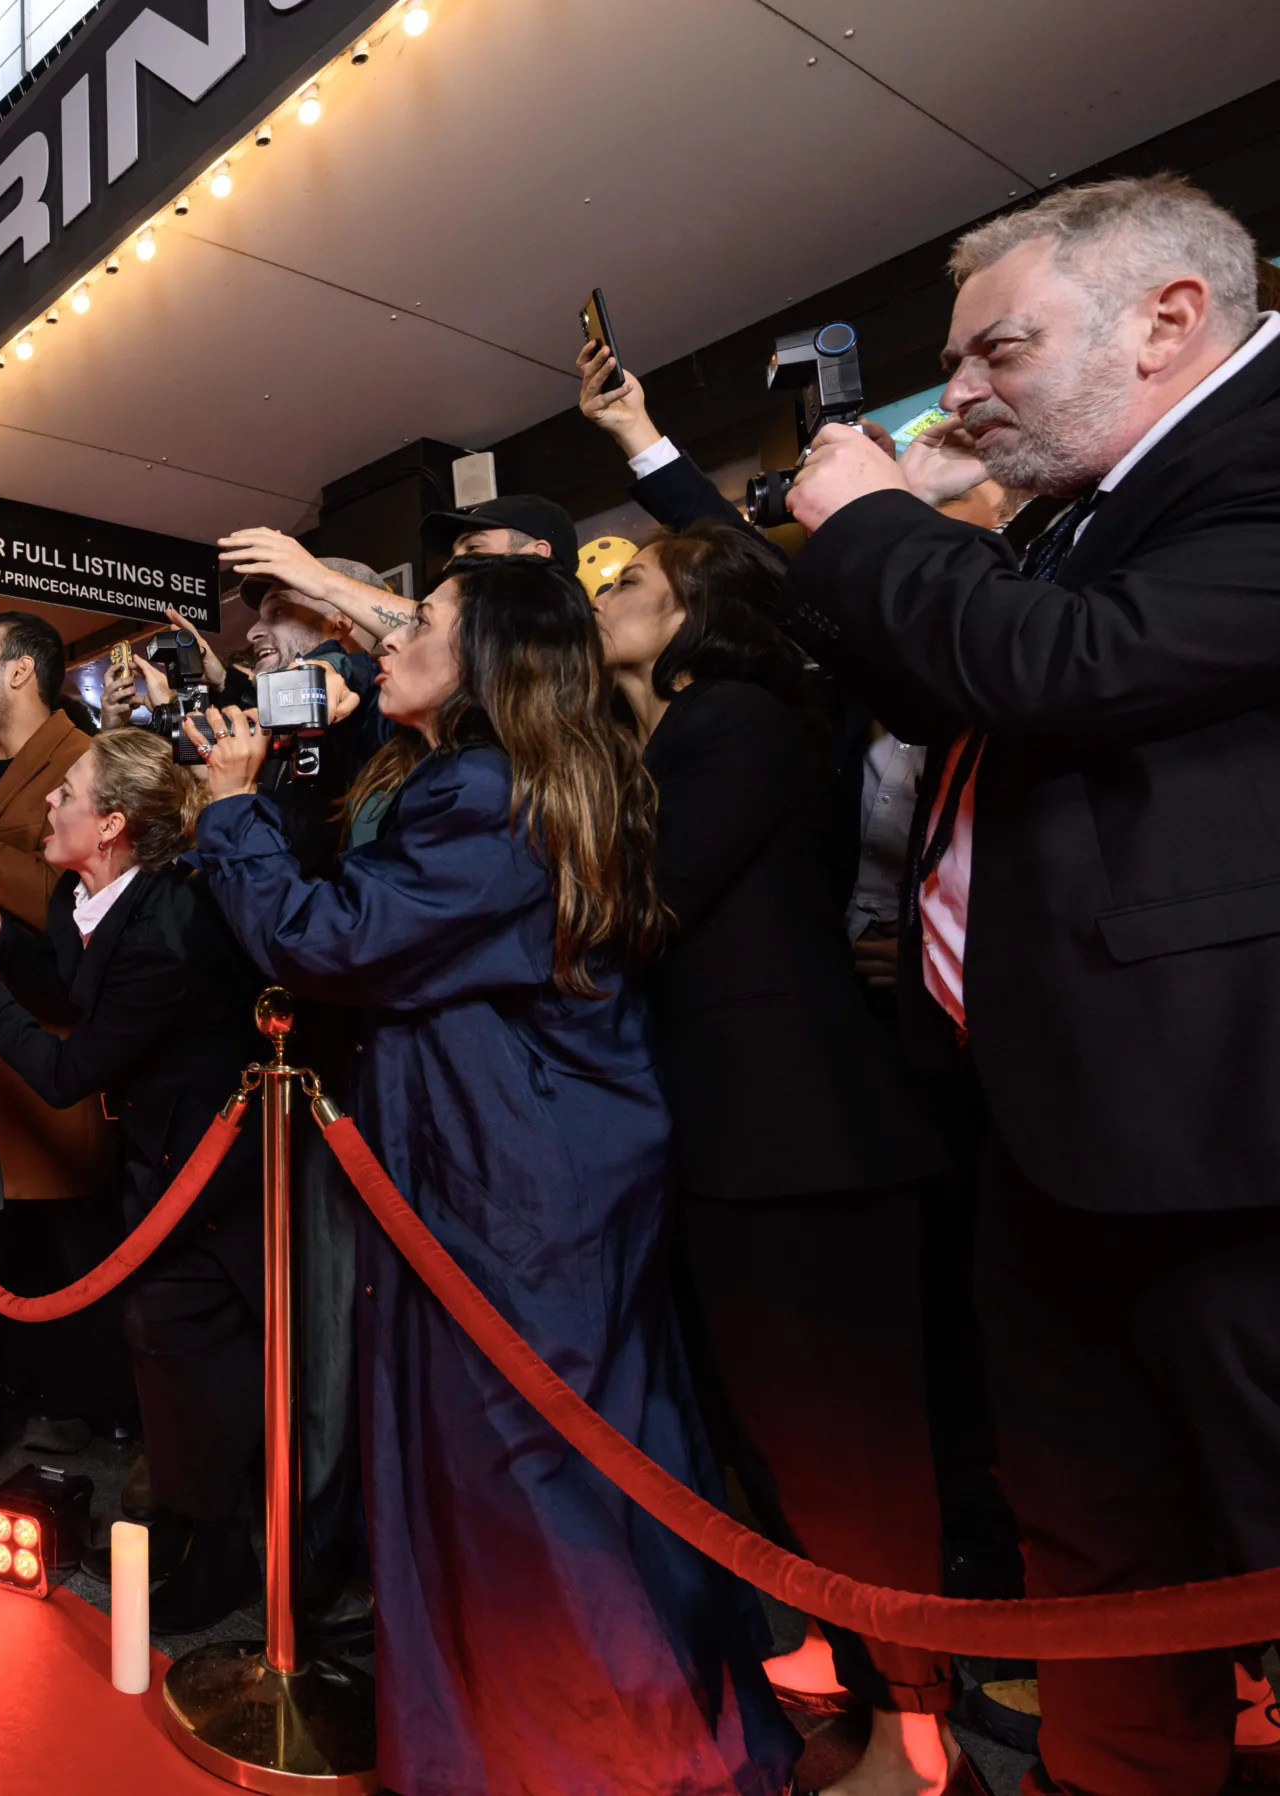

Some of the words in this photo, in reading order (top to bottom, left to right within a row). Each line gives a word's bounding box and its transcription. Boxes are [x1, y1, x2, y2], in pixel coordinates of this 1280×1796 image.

[13, 541, 66, 569] FULL
[73, 553, 164, 588] LISTINGS
[170, 574, 207, 597] SEE
